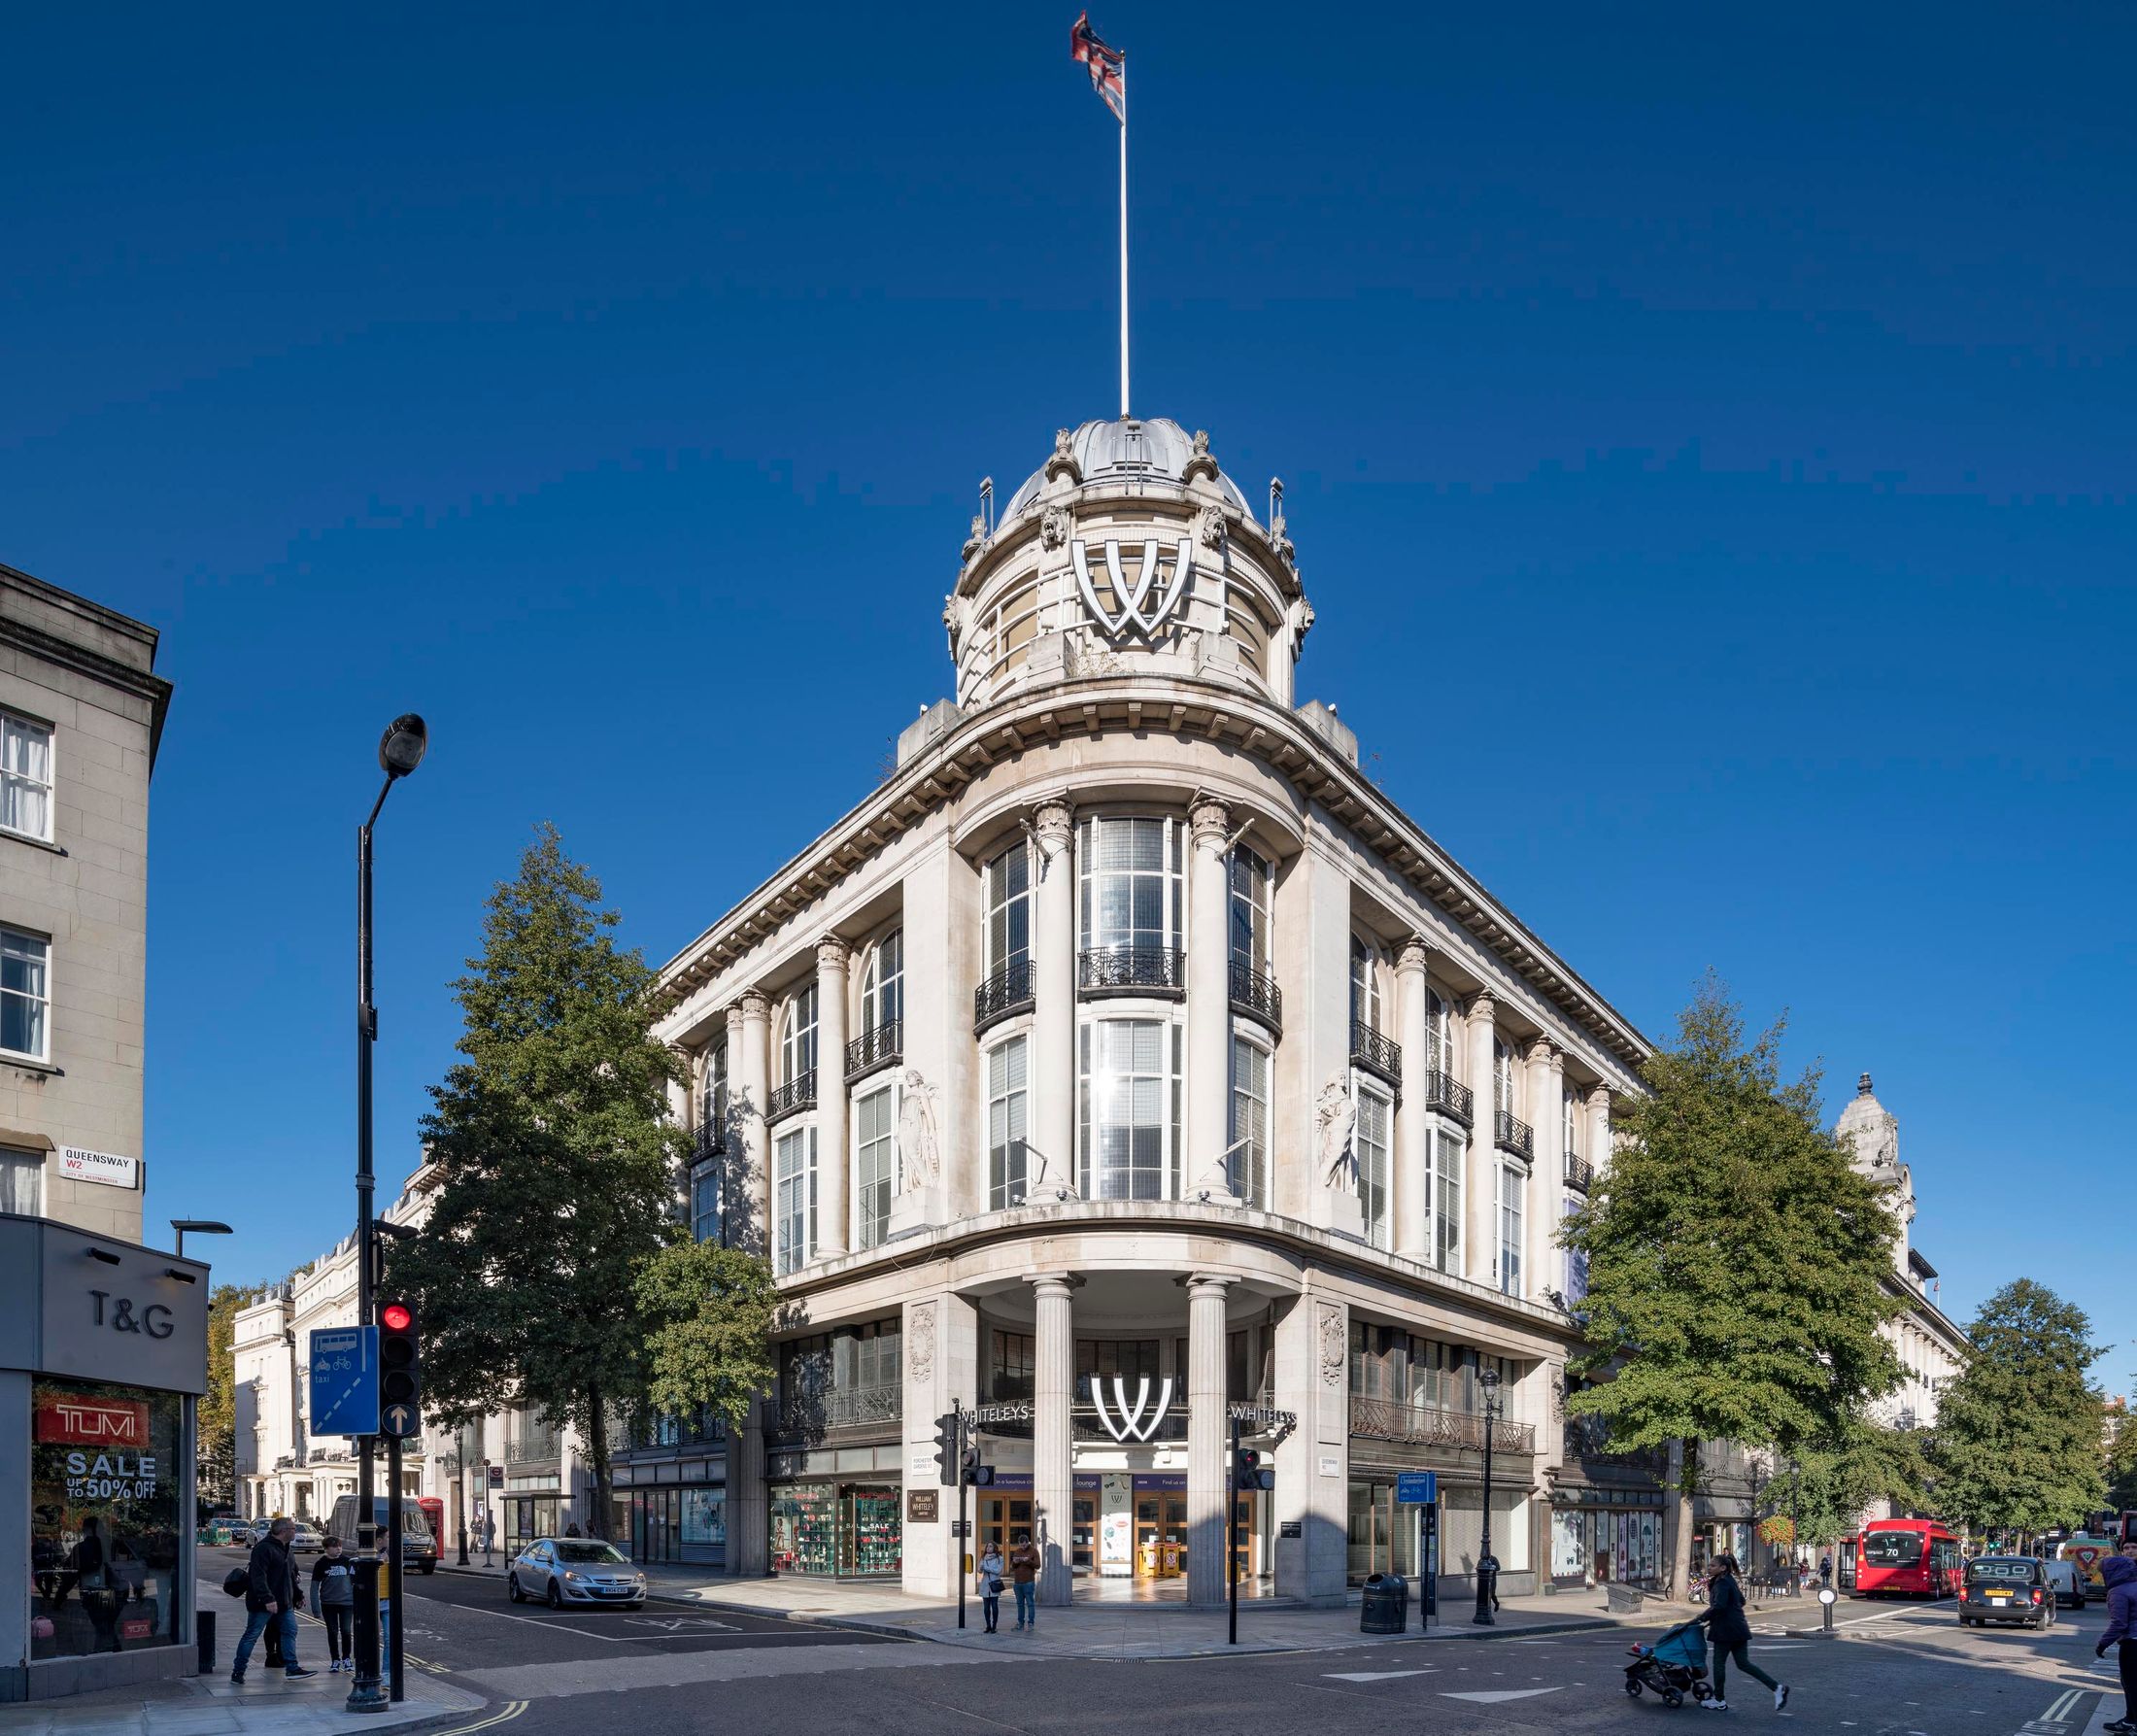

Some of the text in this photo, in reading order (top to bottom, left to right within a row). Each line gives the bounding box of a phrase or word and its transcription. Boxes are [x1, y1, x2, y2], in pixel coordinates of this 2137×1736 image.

[66, 1149, 129, 1168] QUEENSWAY
[66, 1159, 83, 1170] W2
[89, 1289, 174, 1339] T&G
[315, 1375, 330, 1383] taxi
[56, 1404, 135, 1438] TUMI
[1231, 1406, 1297, 1425] WHITELEYS
[67, 1452, 156, 1478] SALE
[67, 1478, 156, 1499] UP TO 50% OFF
